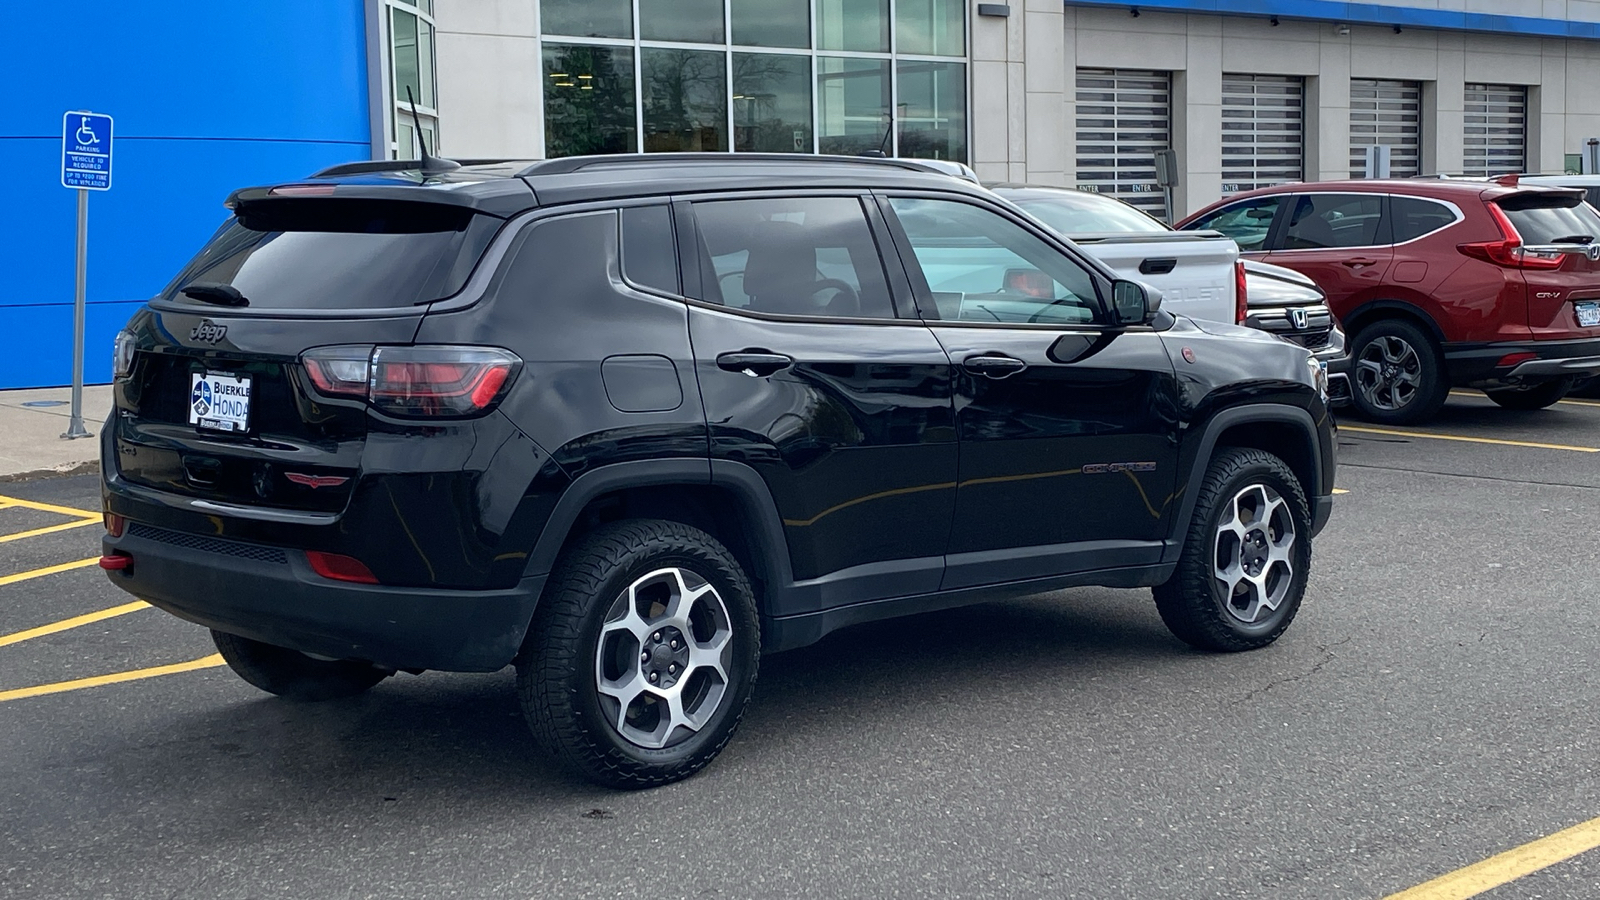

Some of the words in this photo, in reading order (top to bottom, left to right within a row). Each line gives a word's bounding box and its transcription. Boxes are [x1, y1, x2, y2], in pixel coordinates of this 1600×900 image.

[75, 145, 100, 153] PARKING
[73, 162, 102, 170] REQUIRED
[1079, 185, 1099, 193] ENTER
[1132, 184, 1152, 192] ENTER
[1221, 184, 1239, 192] ENTER
[190, 320, 228, 346] Jeep
[213, 381, 250, 398] BUERKLE
